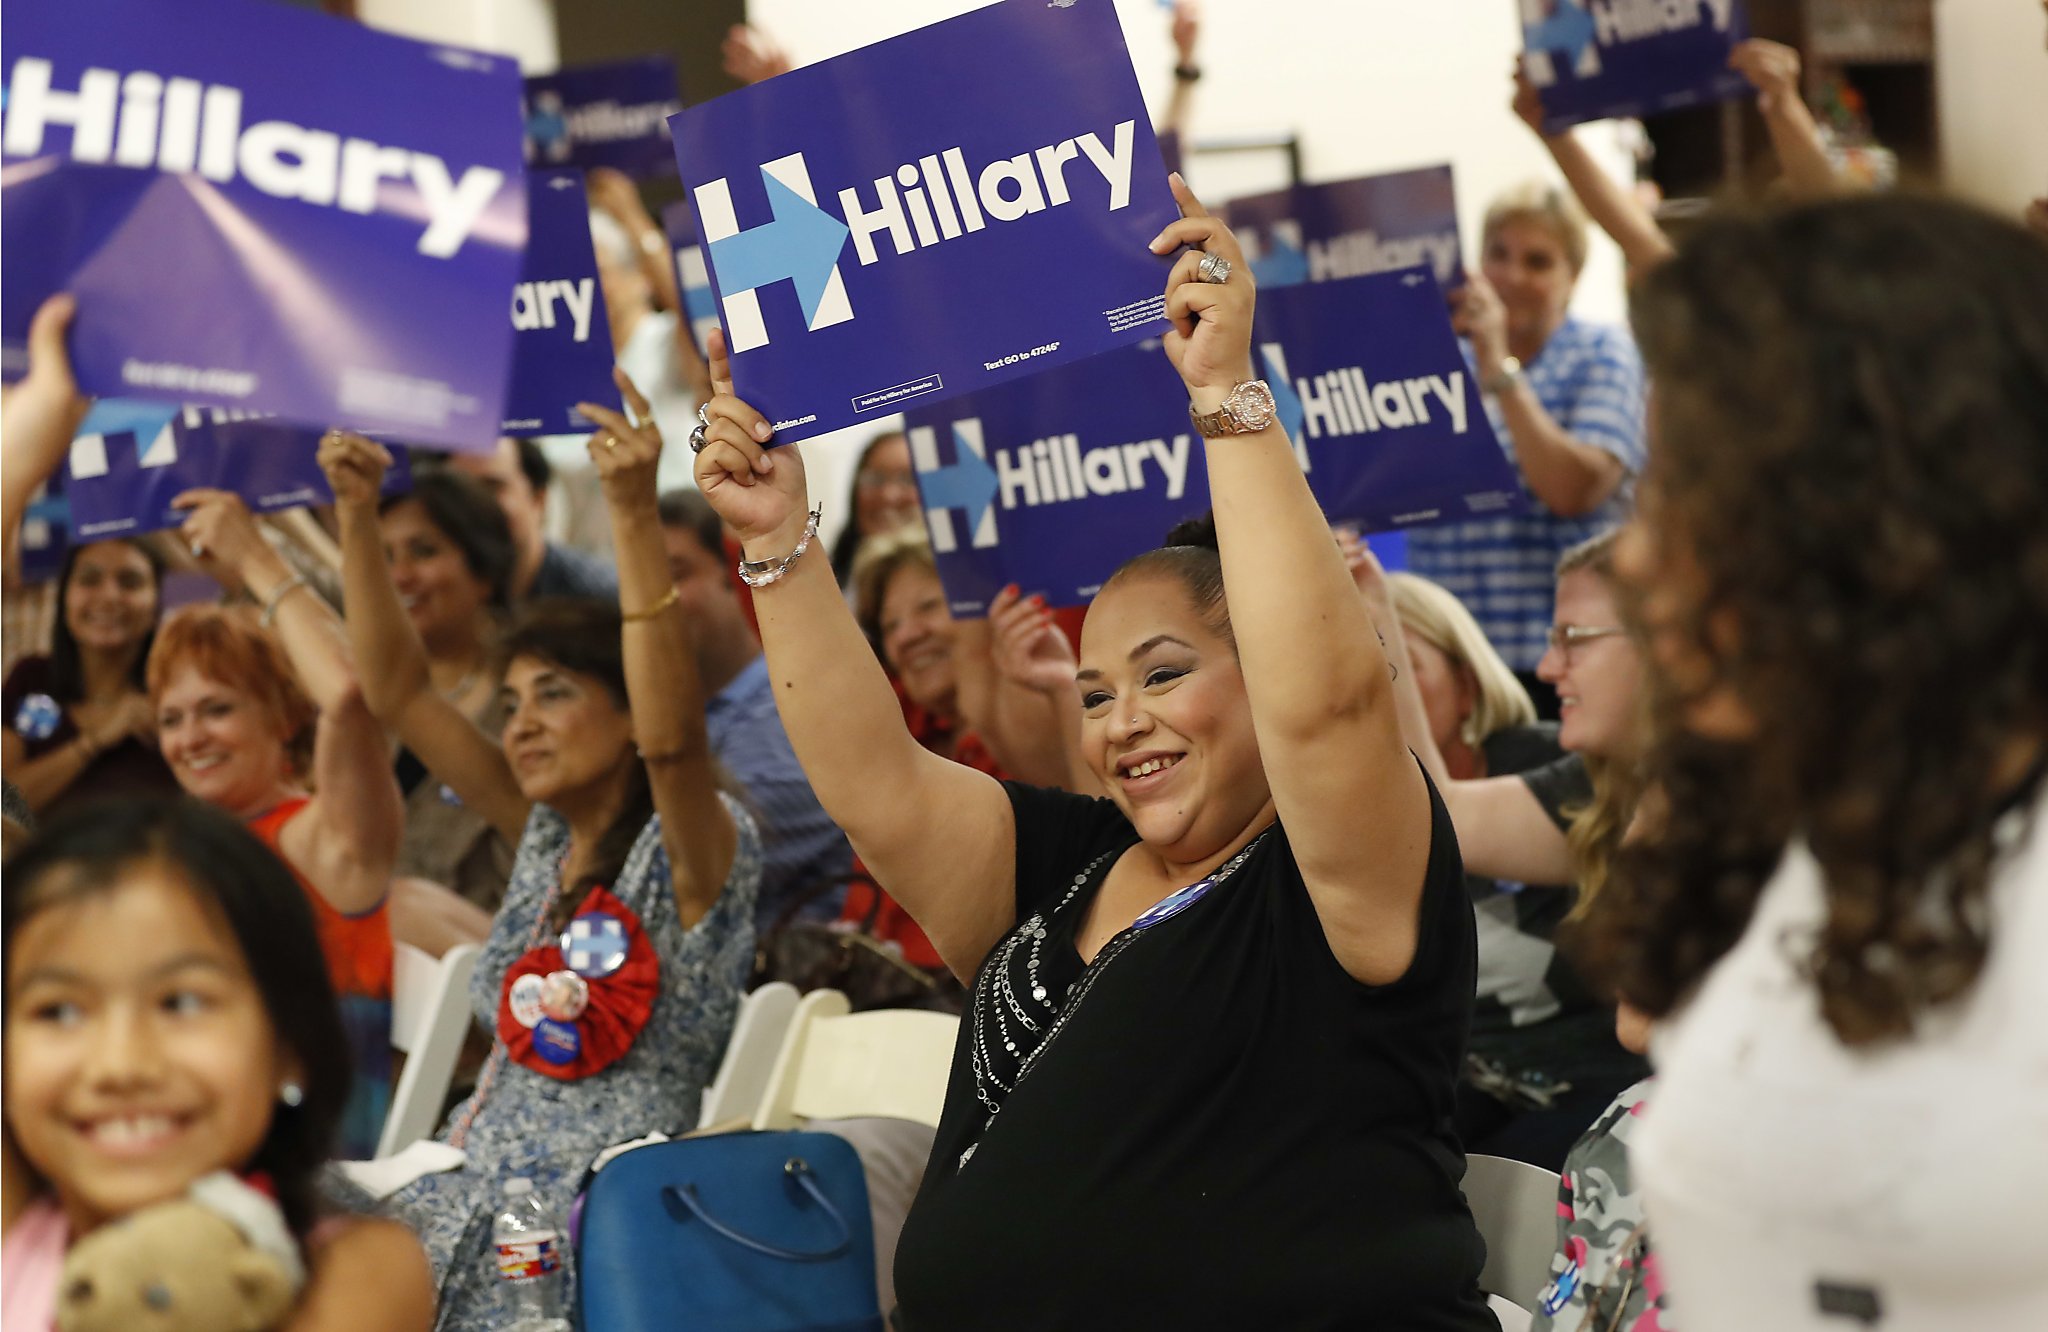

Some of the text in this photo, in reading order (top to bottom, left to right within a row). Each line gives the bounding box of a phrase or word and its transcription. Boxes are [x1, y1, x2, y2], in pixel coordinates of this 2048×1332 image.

[3, 56, 504, 260] Hillary
[838, 119, 1135, 266] Hillary
[886, 391, 903, 399] Hillary
[984, 358, 1005, 371] Text
[1004, 354, 1019, 365] GO
[1019, 352, 1030, 360] to
[1296, 366, 1468, 439] Hillary
[995, 433, 1191, 510] Hillary
